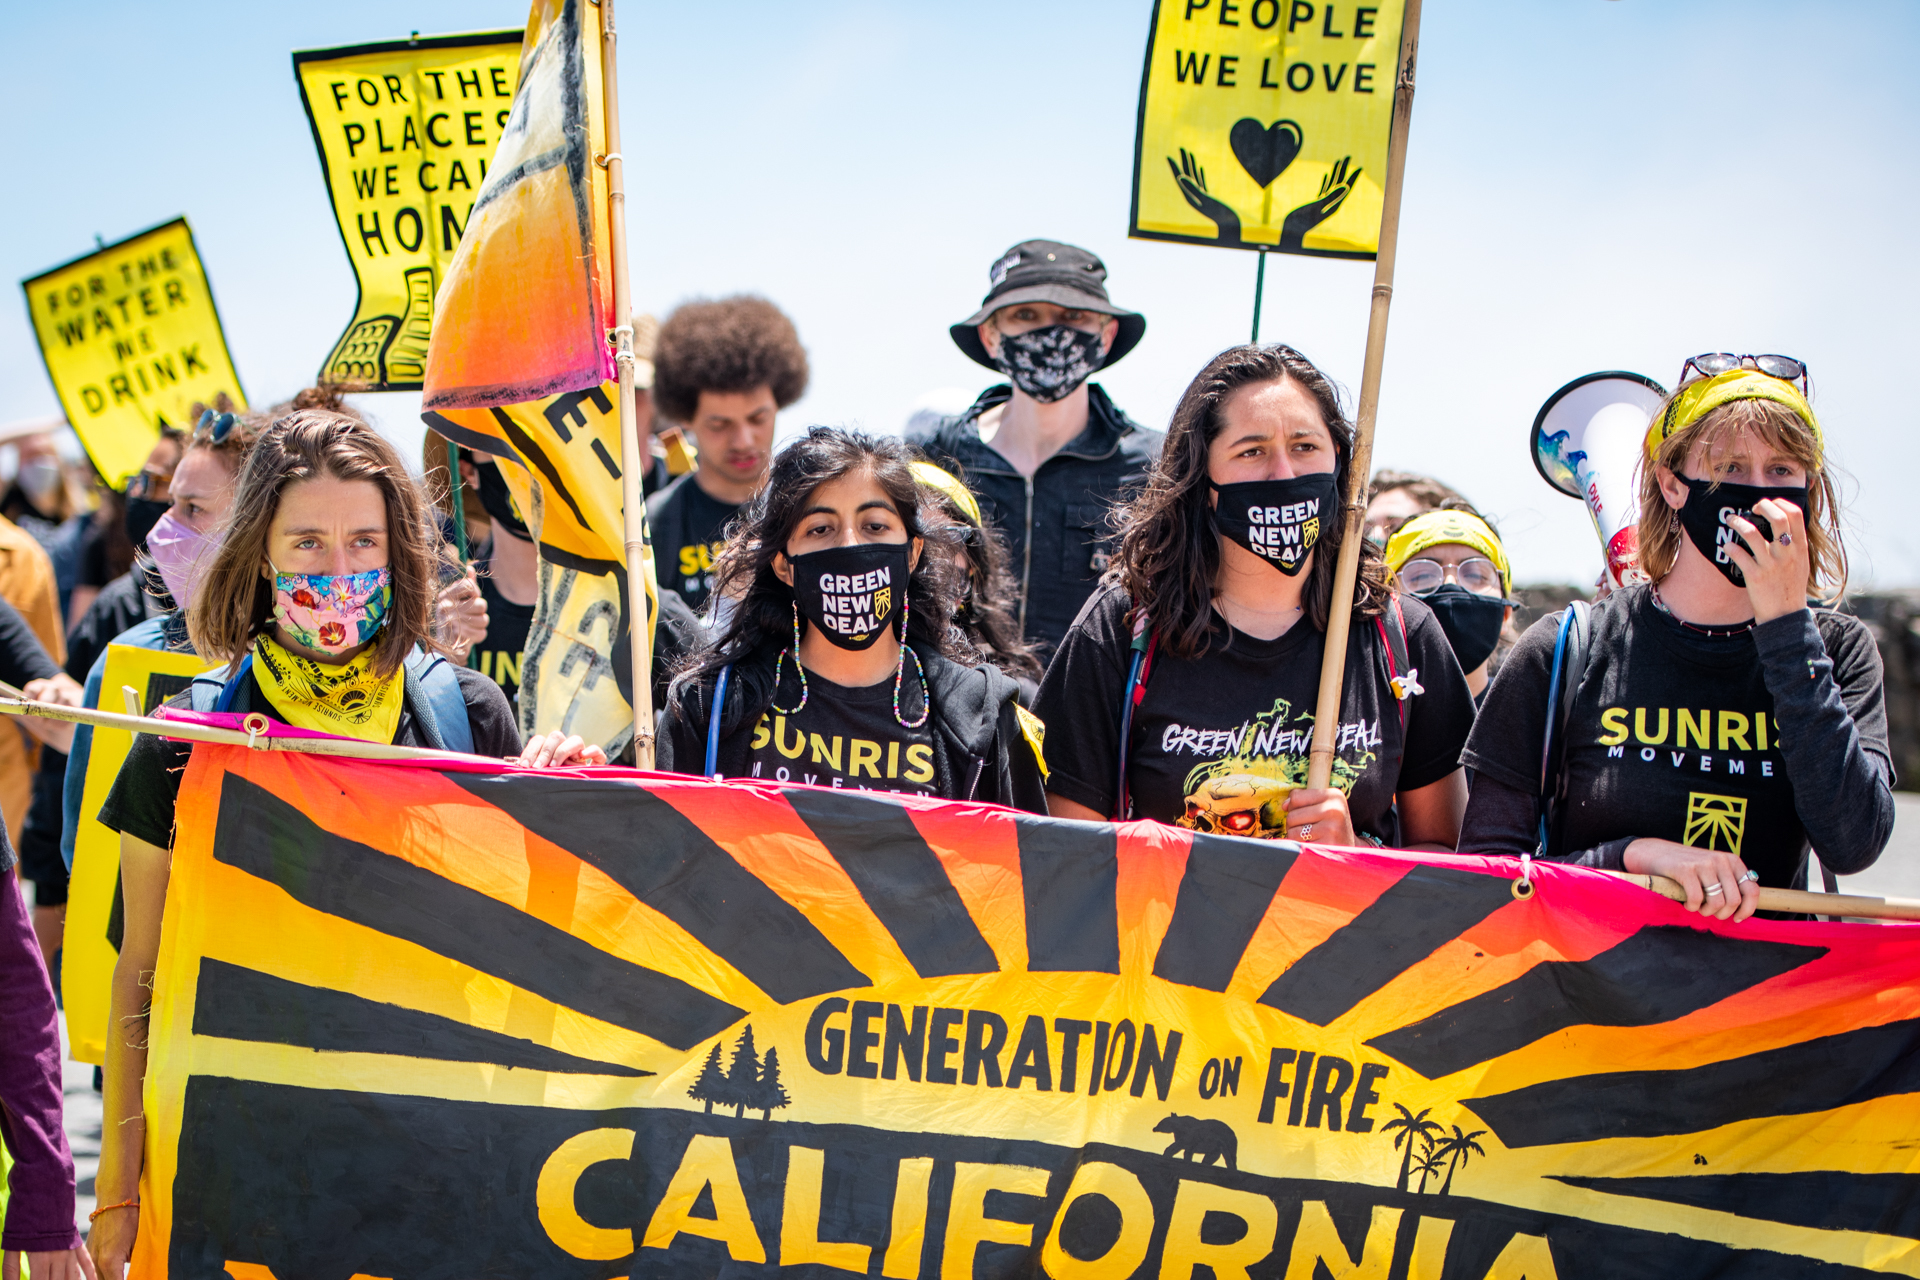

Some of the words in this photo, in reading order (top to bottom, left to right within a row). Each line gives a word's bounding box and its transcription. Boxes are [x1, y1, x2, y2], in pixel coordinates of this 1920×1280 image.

[1184, 0, 1378, 39] PEOPLE
[330, 75, 408, 111] FOR
[425, 68, 511, 100] THE
[1175, 50, 1240, 87] WE
[1260, 58, 1376, 94] LOVE
[353, 165, 399, 200] WE
[47, 275, 106, 315] FOR
[118, 248, 178, 286] THE
[56, 279, 188, 347] WATER
[112, 327, 154, 361] WE
[81, 342, 209, 414] DRINK
[1247, 497, 1320, 525] GREEN
[1588, 482, 1603, 518] PYLE
[1248, 524, 1300, 545] NEW
[1251, 542, 1303, 563] DEAL
[819, 566, 891, 594] GREEN
[822, 593, 872, 614] NEW
[823, 613, 879, 634] DEAL
[312, 701, 343, 722] SUNRISE
[1599, 707, 1780, 751] SUNRI
[1162, 719, 1250, 757] GREEN
[1252, 714, 1315, 757] NEW
[1607, 745, 1774, 777] MOVEME
[804, 996, 1184, 1102] GENERATION
[1198, 1056, 1243, 1100] ON
[1257, 1047, 1390, 1134] FIRE
